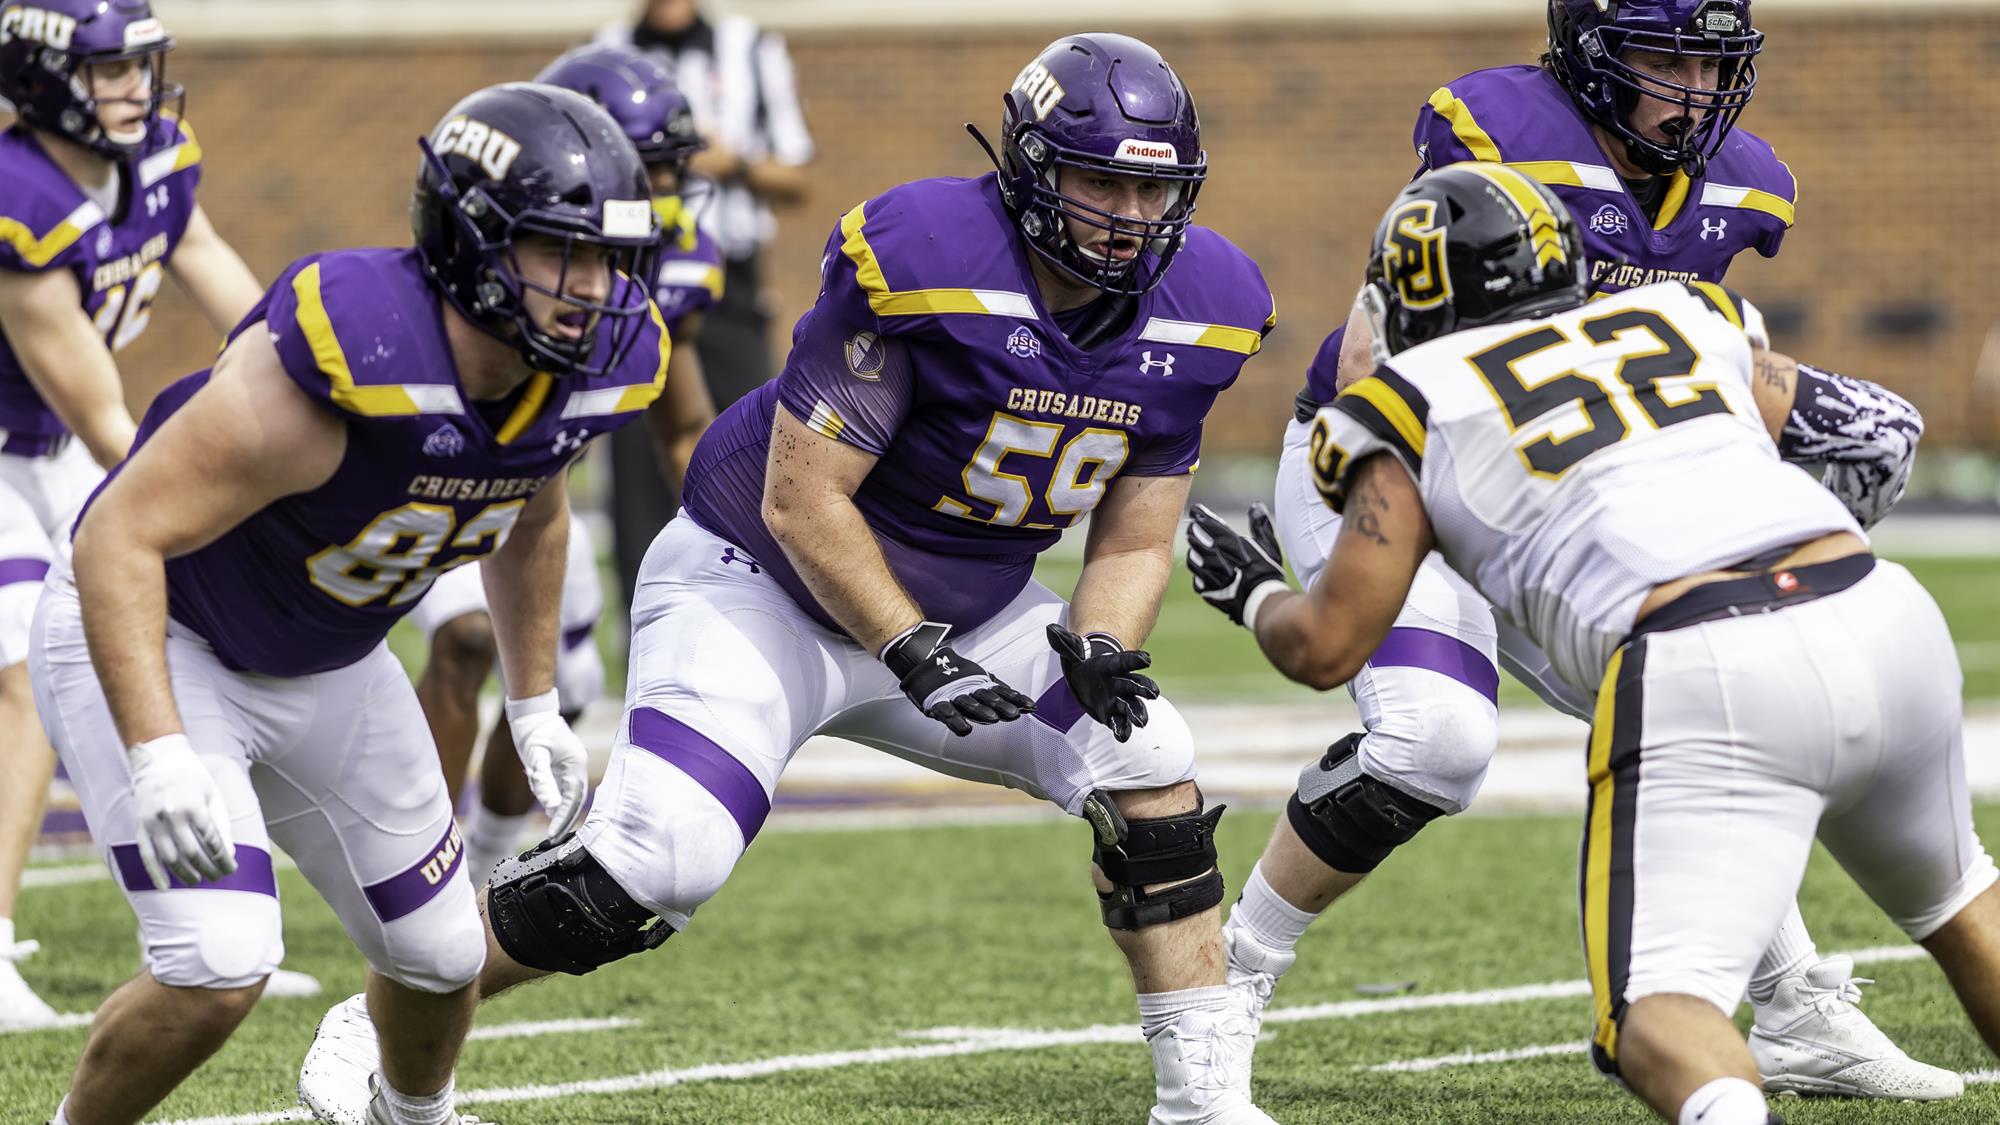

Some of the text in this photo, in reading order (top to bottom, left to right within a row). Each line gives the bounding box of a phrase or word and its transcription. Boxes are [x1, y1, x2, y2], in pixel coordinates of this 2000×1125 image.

[1010, 58, 1066, 122] CRU
[432, 114, 521, 181] CRU
[1126, 145, 1172, 159] Riddell
[1007, 387, 1142, 426] CRUSADERS
[1463, 307, 1736, 481] 52
[931, 410, 1129, 529] 59
